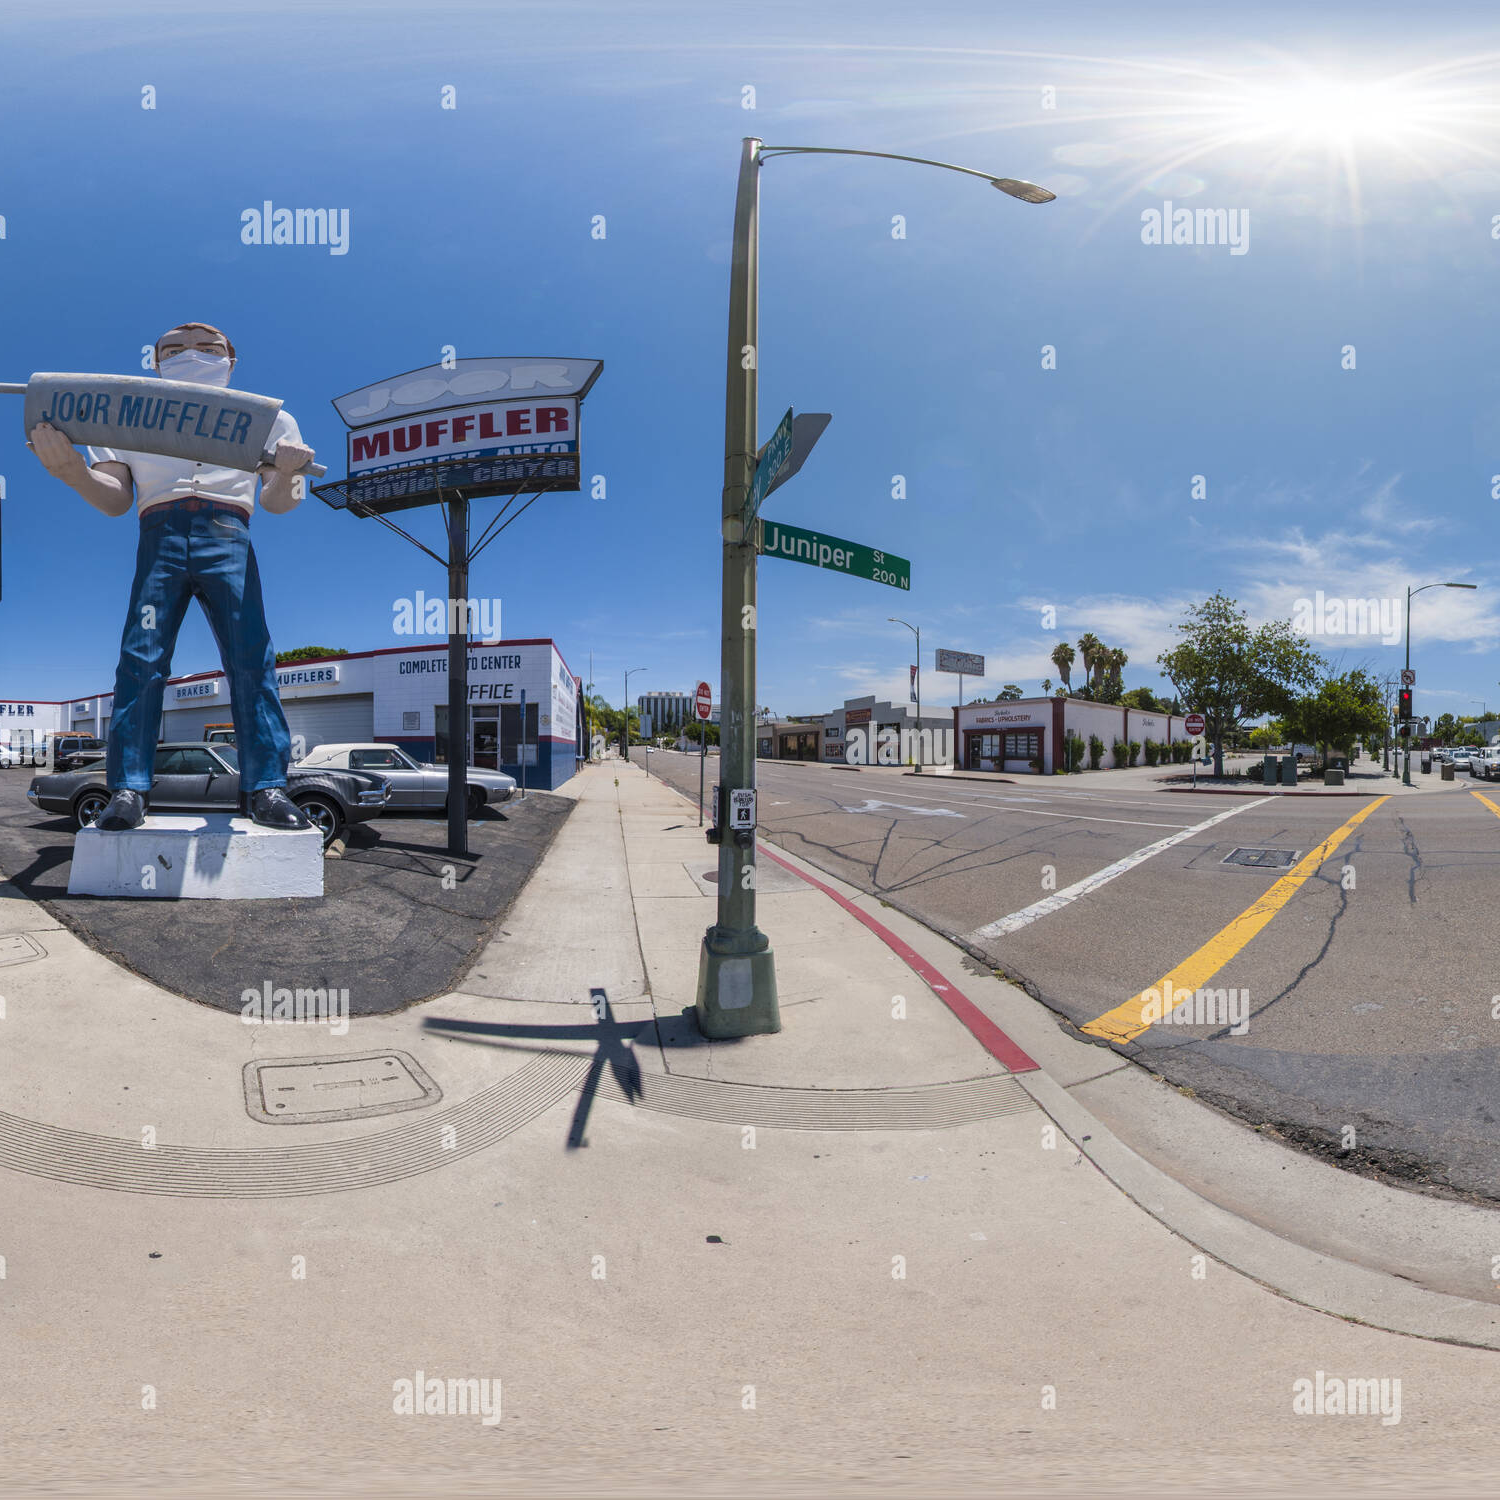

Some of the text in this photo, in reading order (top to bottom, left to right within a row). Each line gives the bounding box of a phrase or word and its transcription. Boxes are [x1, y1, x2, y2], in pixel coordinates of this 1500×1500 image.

[348, 364, 573, 417] JOOR
[42, 391, 252, 444] JOOR MUFFLER
[352, 407, 570, 462] MUFFLER
[765, 527, 854, 569] Juniper
[873, 550, 885, 564] St
[872, 568, 908, 589] 200 N
[400, 658, 447, 674] COMPLETE
[481, 655, 521, 669] CENTER
[176, 685, 210, 698] BRAKES
[467, 683, 514, 699] FFICE
